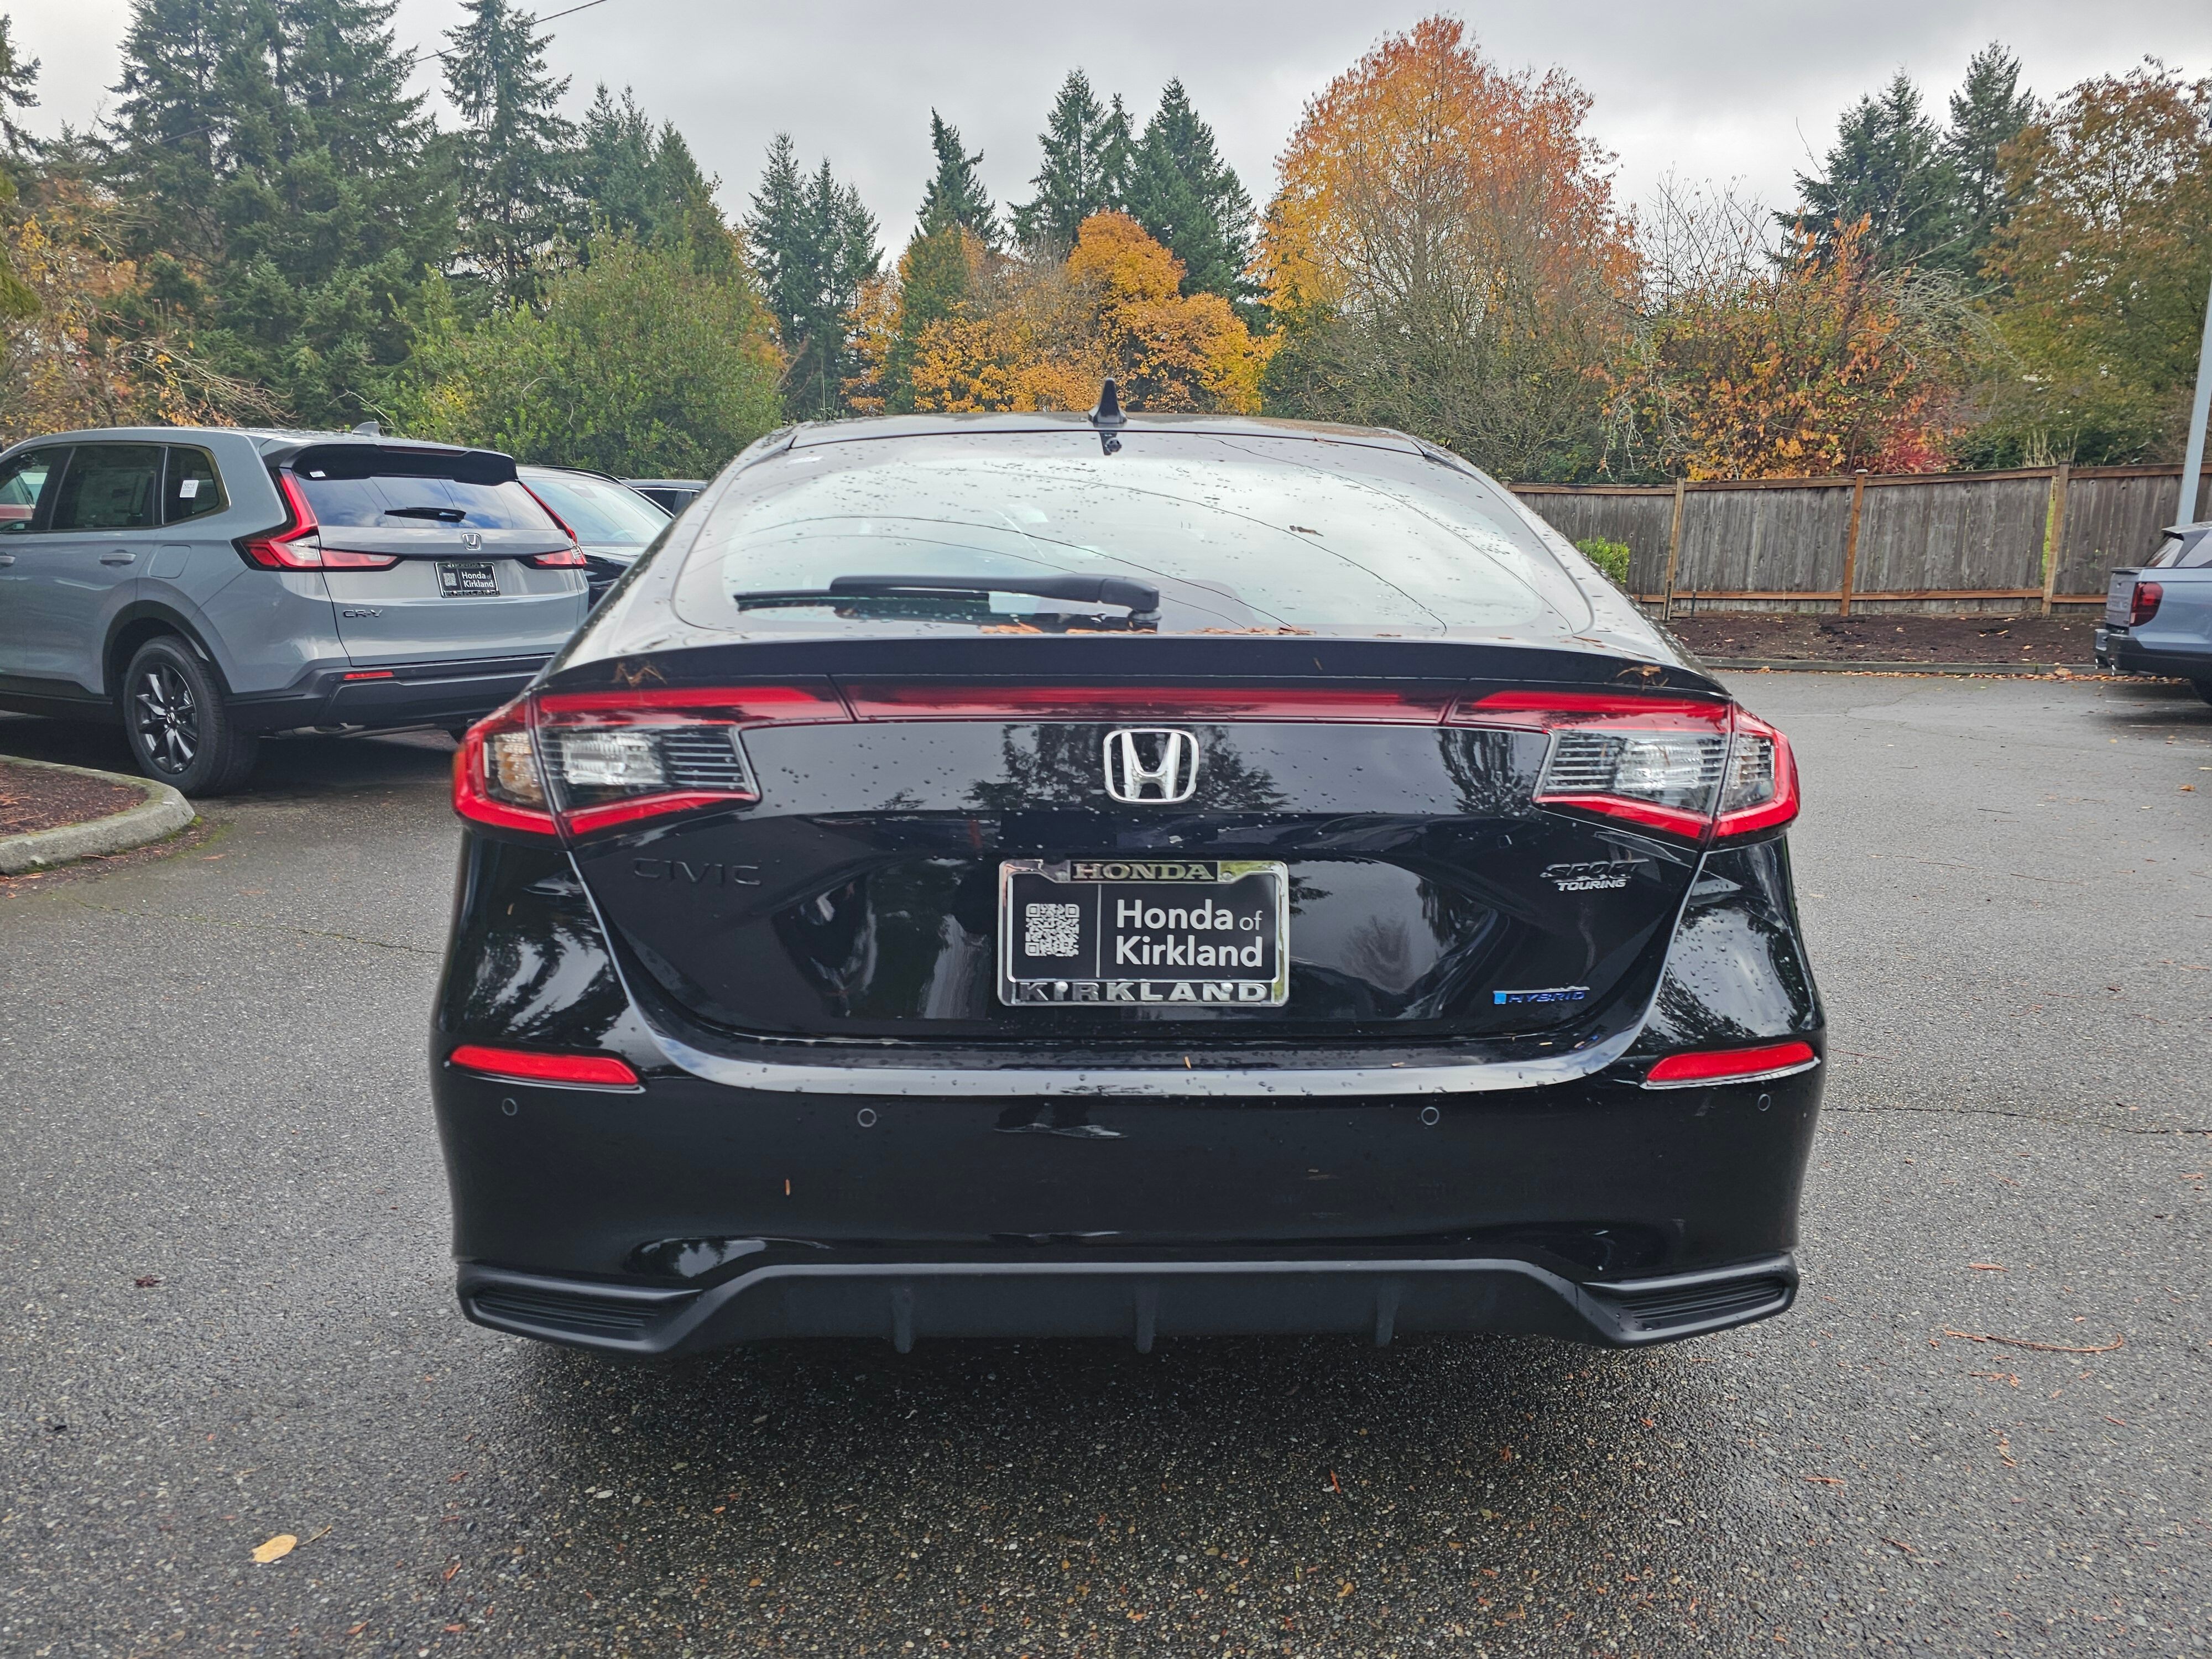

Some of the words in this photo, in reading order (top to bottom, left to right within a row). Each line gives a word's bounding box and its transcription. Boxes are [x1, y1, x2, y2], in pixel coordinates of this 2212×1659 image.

[343, 609, 383, 618] CR-V
[634, 858, 761, 886] CIVIC
[1072, 863, 1215, 881] HONDA
[1539, 858, 1650, 879] SPORT
[1557, 879, 1627, 891] TOURING
[1116, 899, 1234, 930] Honda
[1239, 910, 1263, 931] of
[1116, 935, 1263, 967] Kirkland
[1507, 991, 1585, 1003] HYBRID
